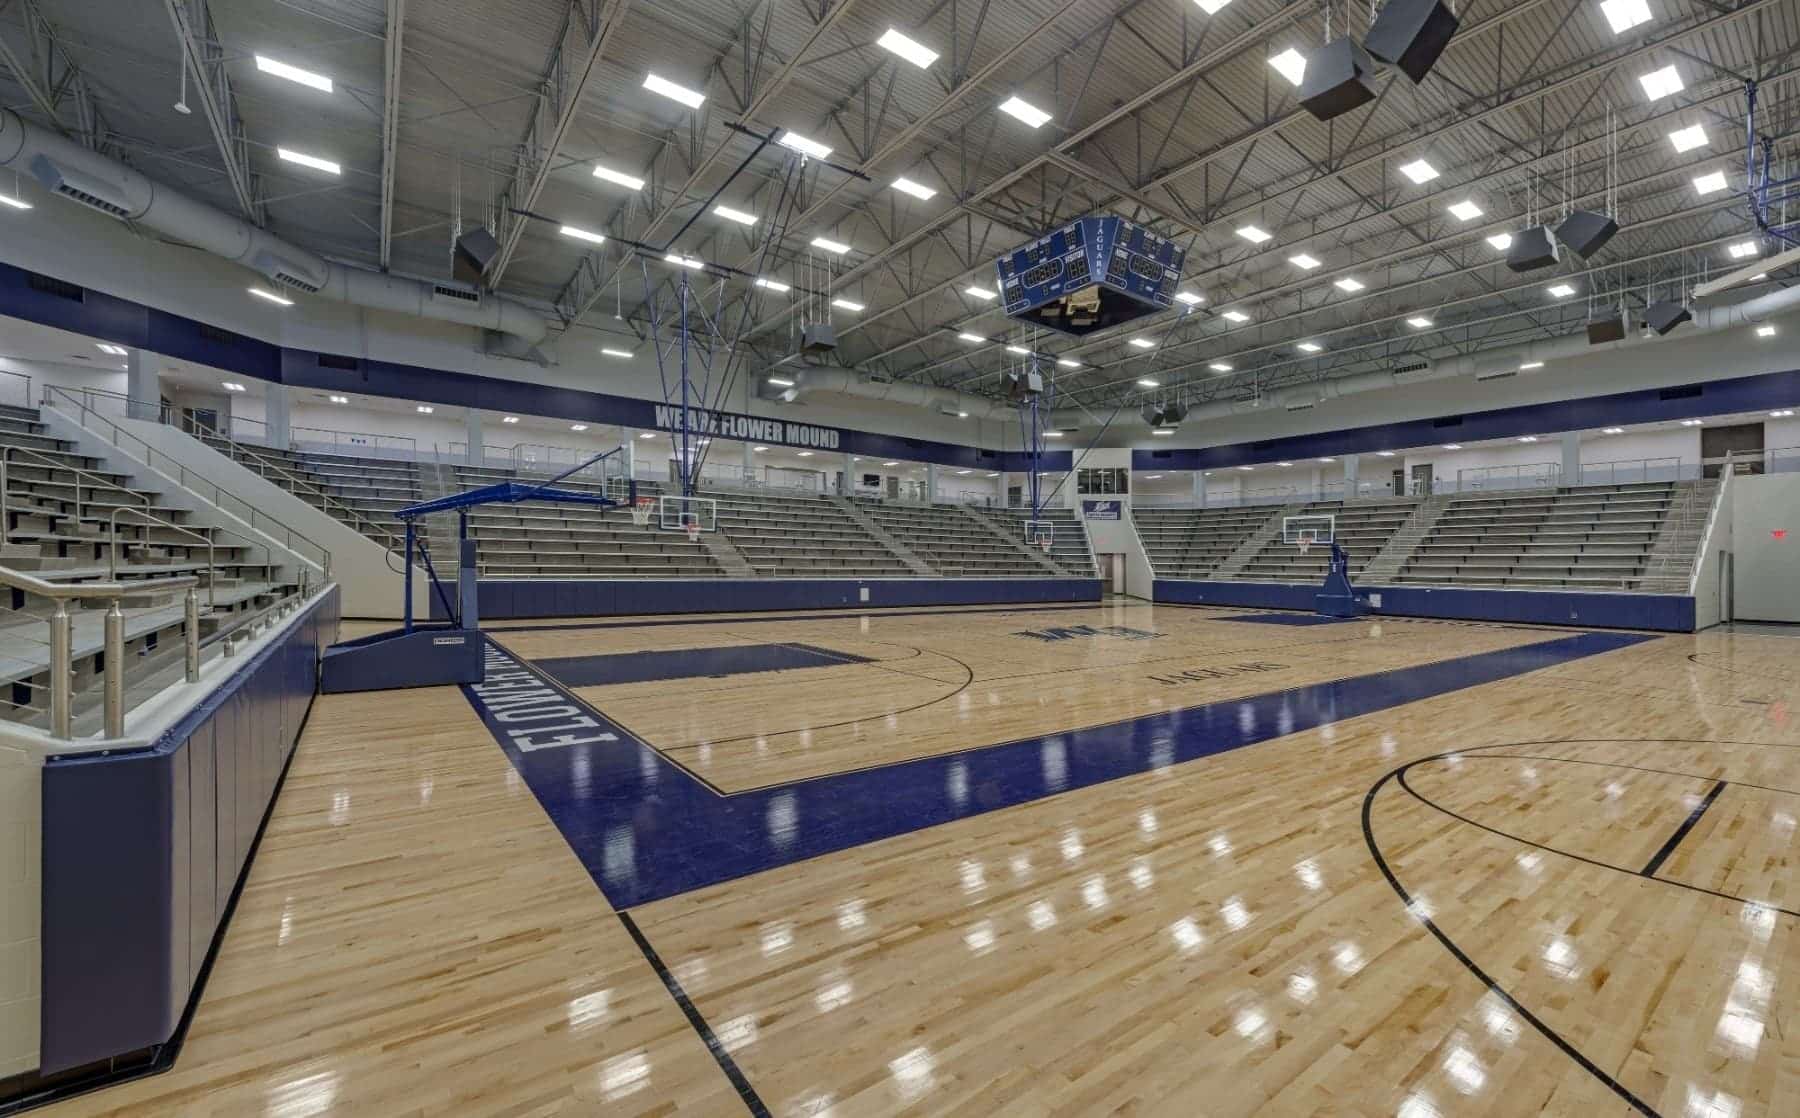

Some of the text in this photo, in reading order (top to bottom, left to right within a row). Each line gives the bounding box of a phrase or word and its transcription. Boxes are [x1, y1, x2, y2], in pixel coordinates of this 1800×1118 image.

[655, 406, 683, 430] WE
[721, 415, 782, 443] FLOWER
[786, 422, 840, 449] MOUND
